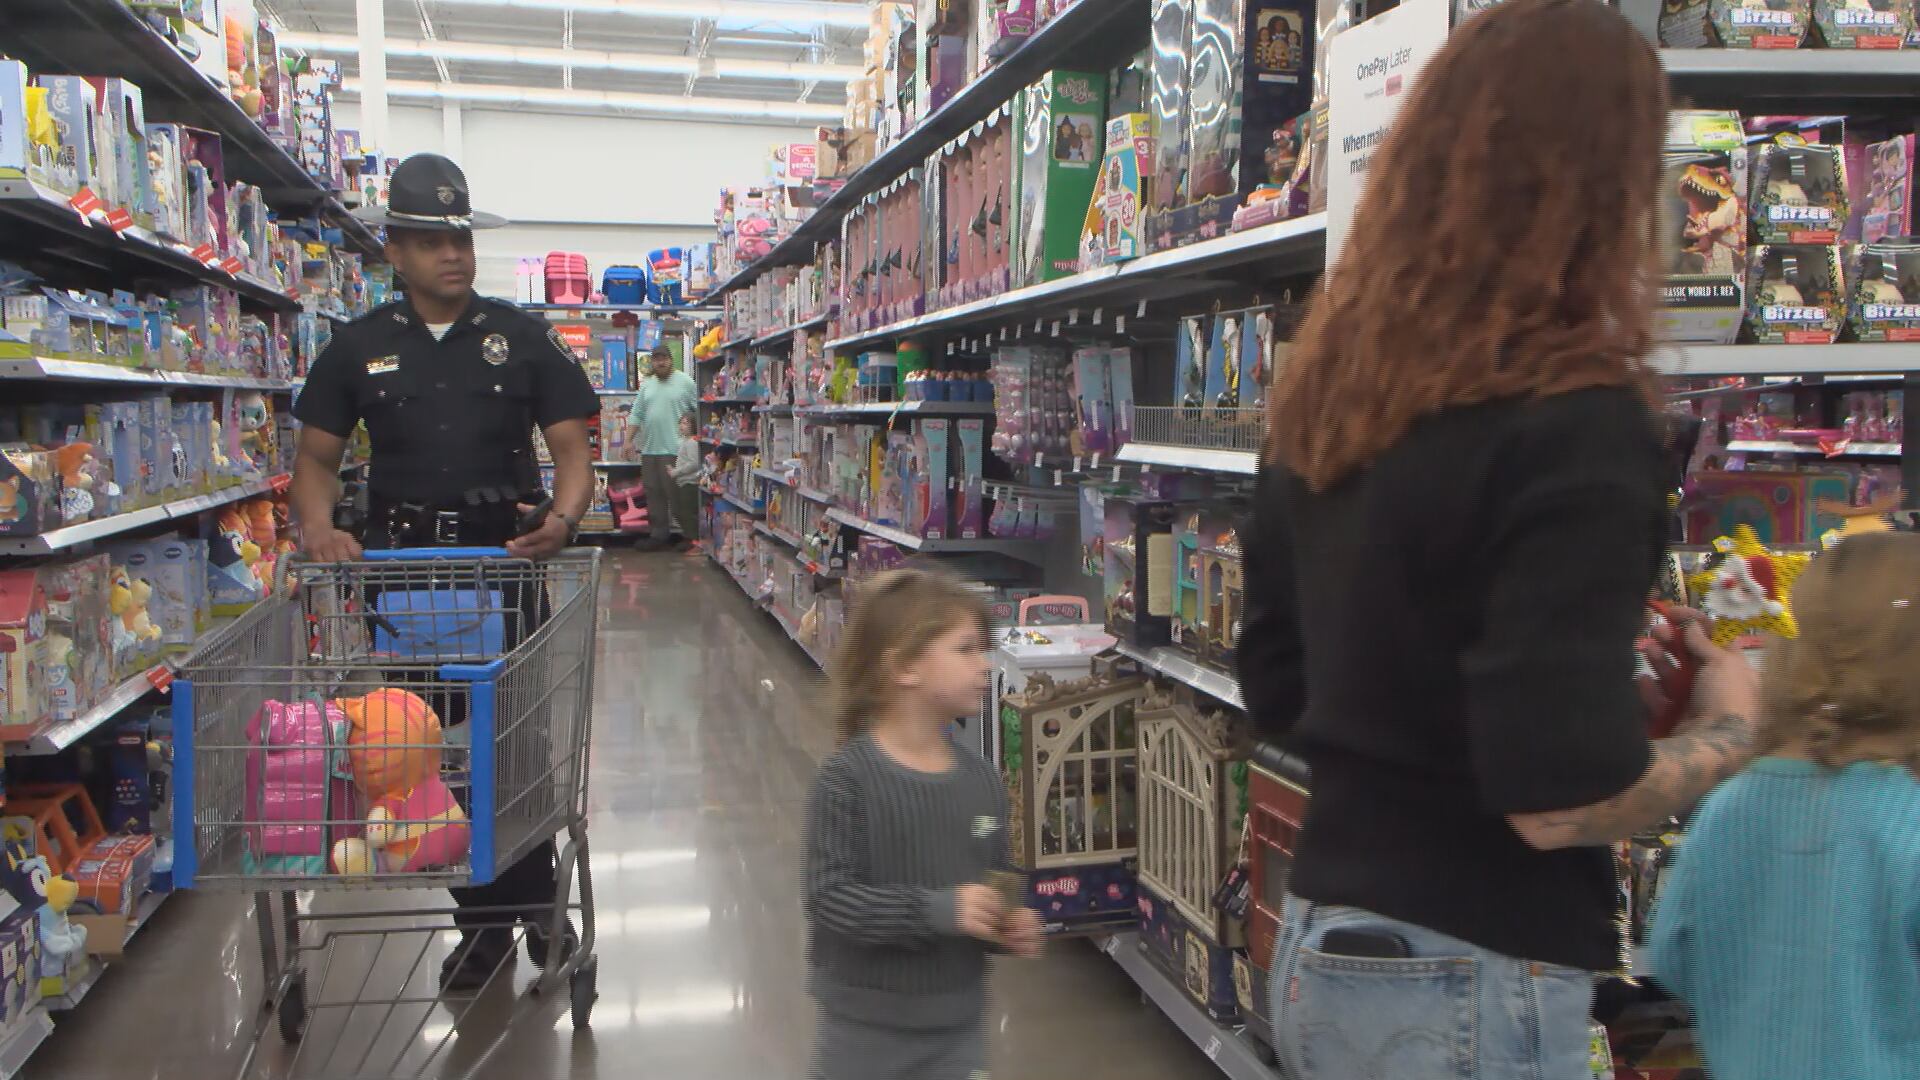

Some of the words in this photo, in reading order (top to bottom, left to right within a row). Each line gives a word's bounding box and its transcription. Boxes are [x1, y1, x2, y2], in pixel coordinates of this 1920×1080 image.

[1357, 56, 1388, 80] OnePay
[1390, 47, 1412, 69] Later
[1343, 133, 1366, 154] When
[1660, 286, 1686, 297] RASSIC
[1687, 286, 1711, 297] WORLD
[1720, 286, 1735, 297] REX
